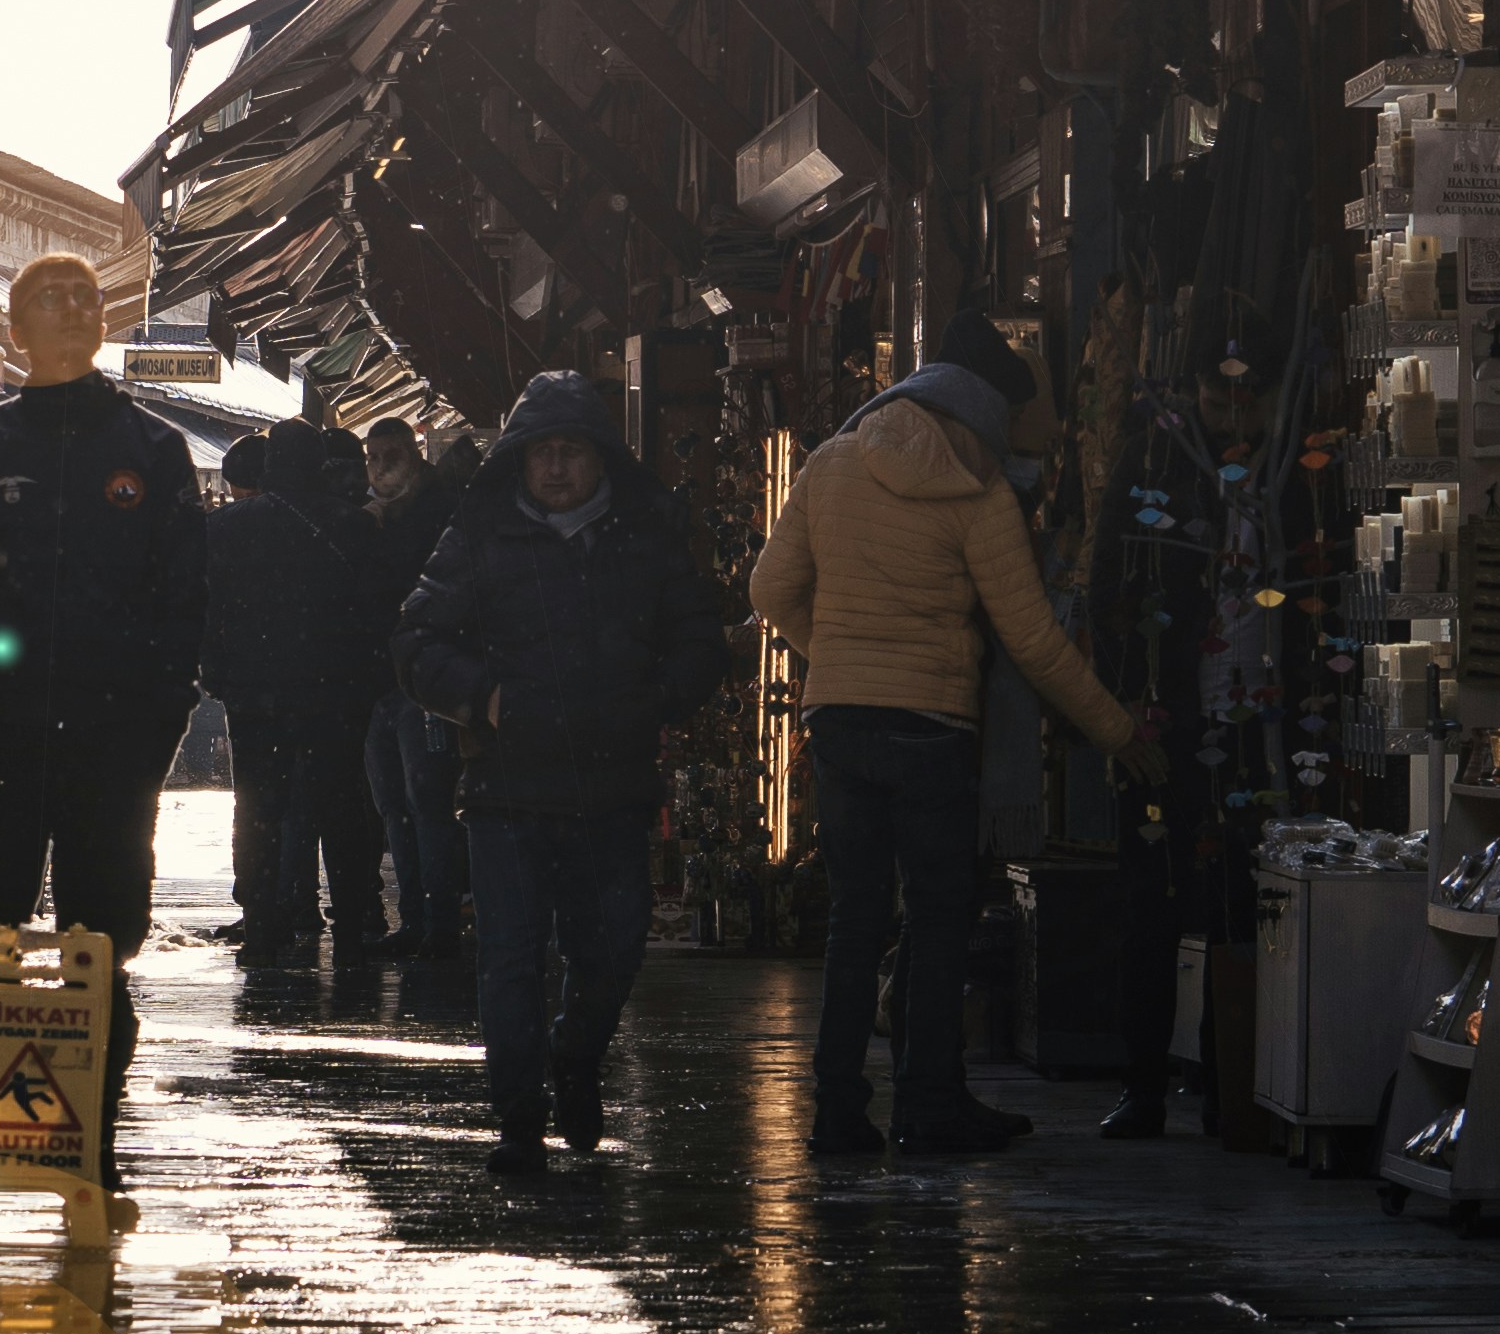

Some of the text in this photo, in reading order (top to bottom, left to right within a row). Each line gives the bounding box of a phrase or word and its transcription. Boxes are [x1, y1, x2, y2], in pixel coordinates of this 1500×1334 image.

[140, 358, 216, 378] MOSAIC MUSEUM
[41, 1028, 89, 1040] ZEMİN
[16, 1154, 82, 1168] FLOOR
